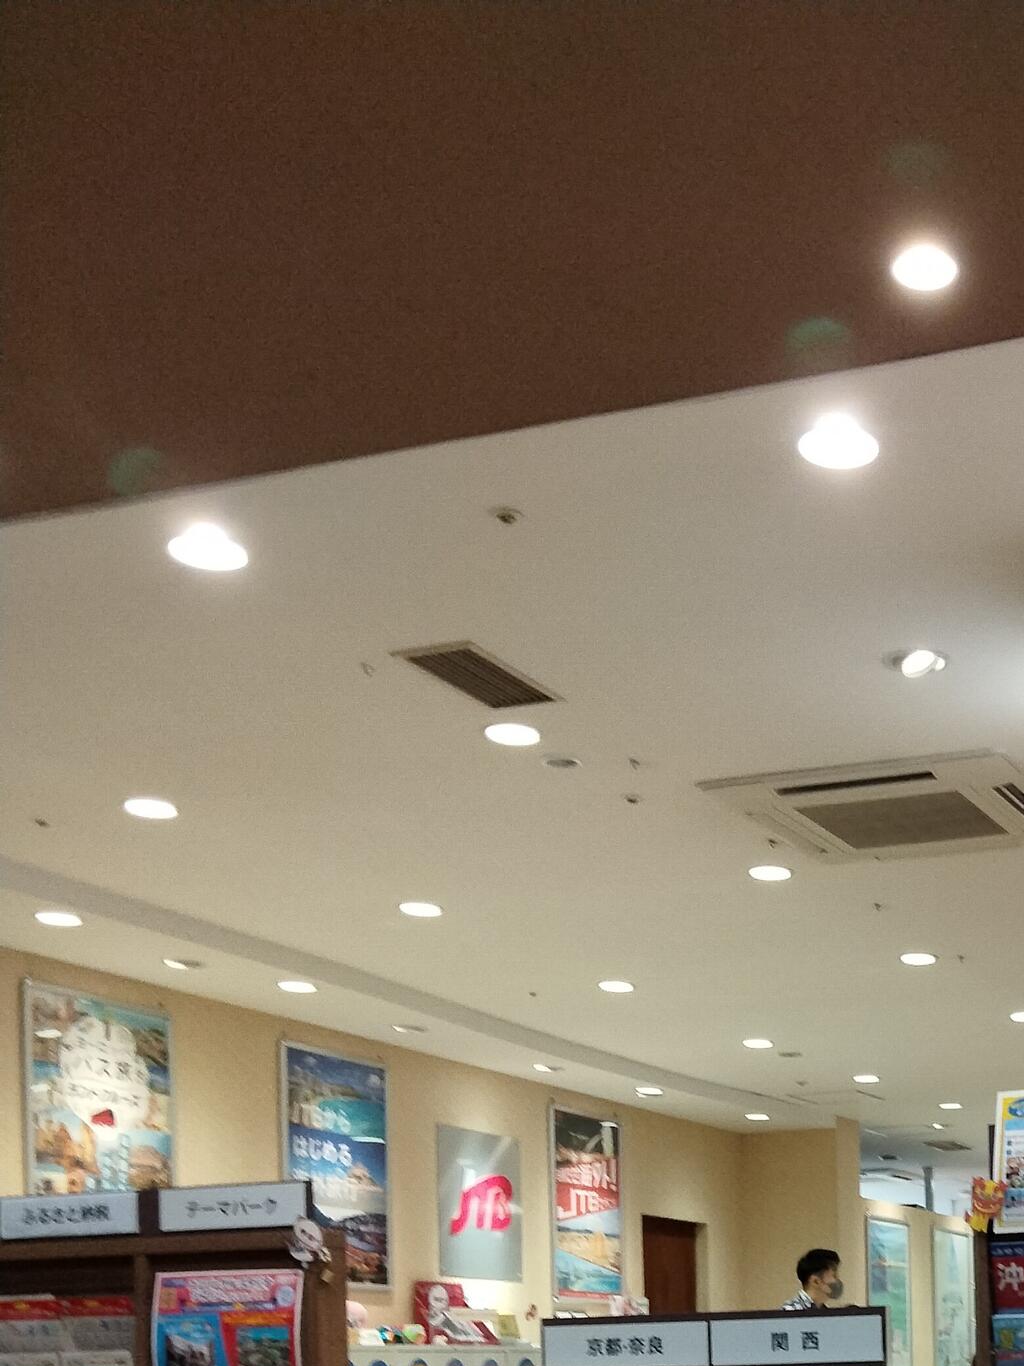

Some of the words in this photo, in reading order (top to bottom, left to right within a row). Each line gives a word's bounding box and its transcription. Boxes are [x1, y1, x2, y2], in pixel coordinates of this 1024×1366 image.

[185, 1197, 278, 1218] テーマパーク
[450, 1173, 513, 1237] JTB
[771, 1331, 820, 1353] 関西
